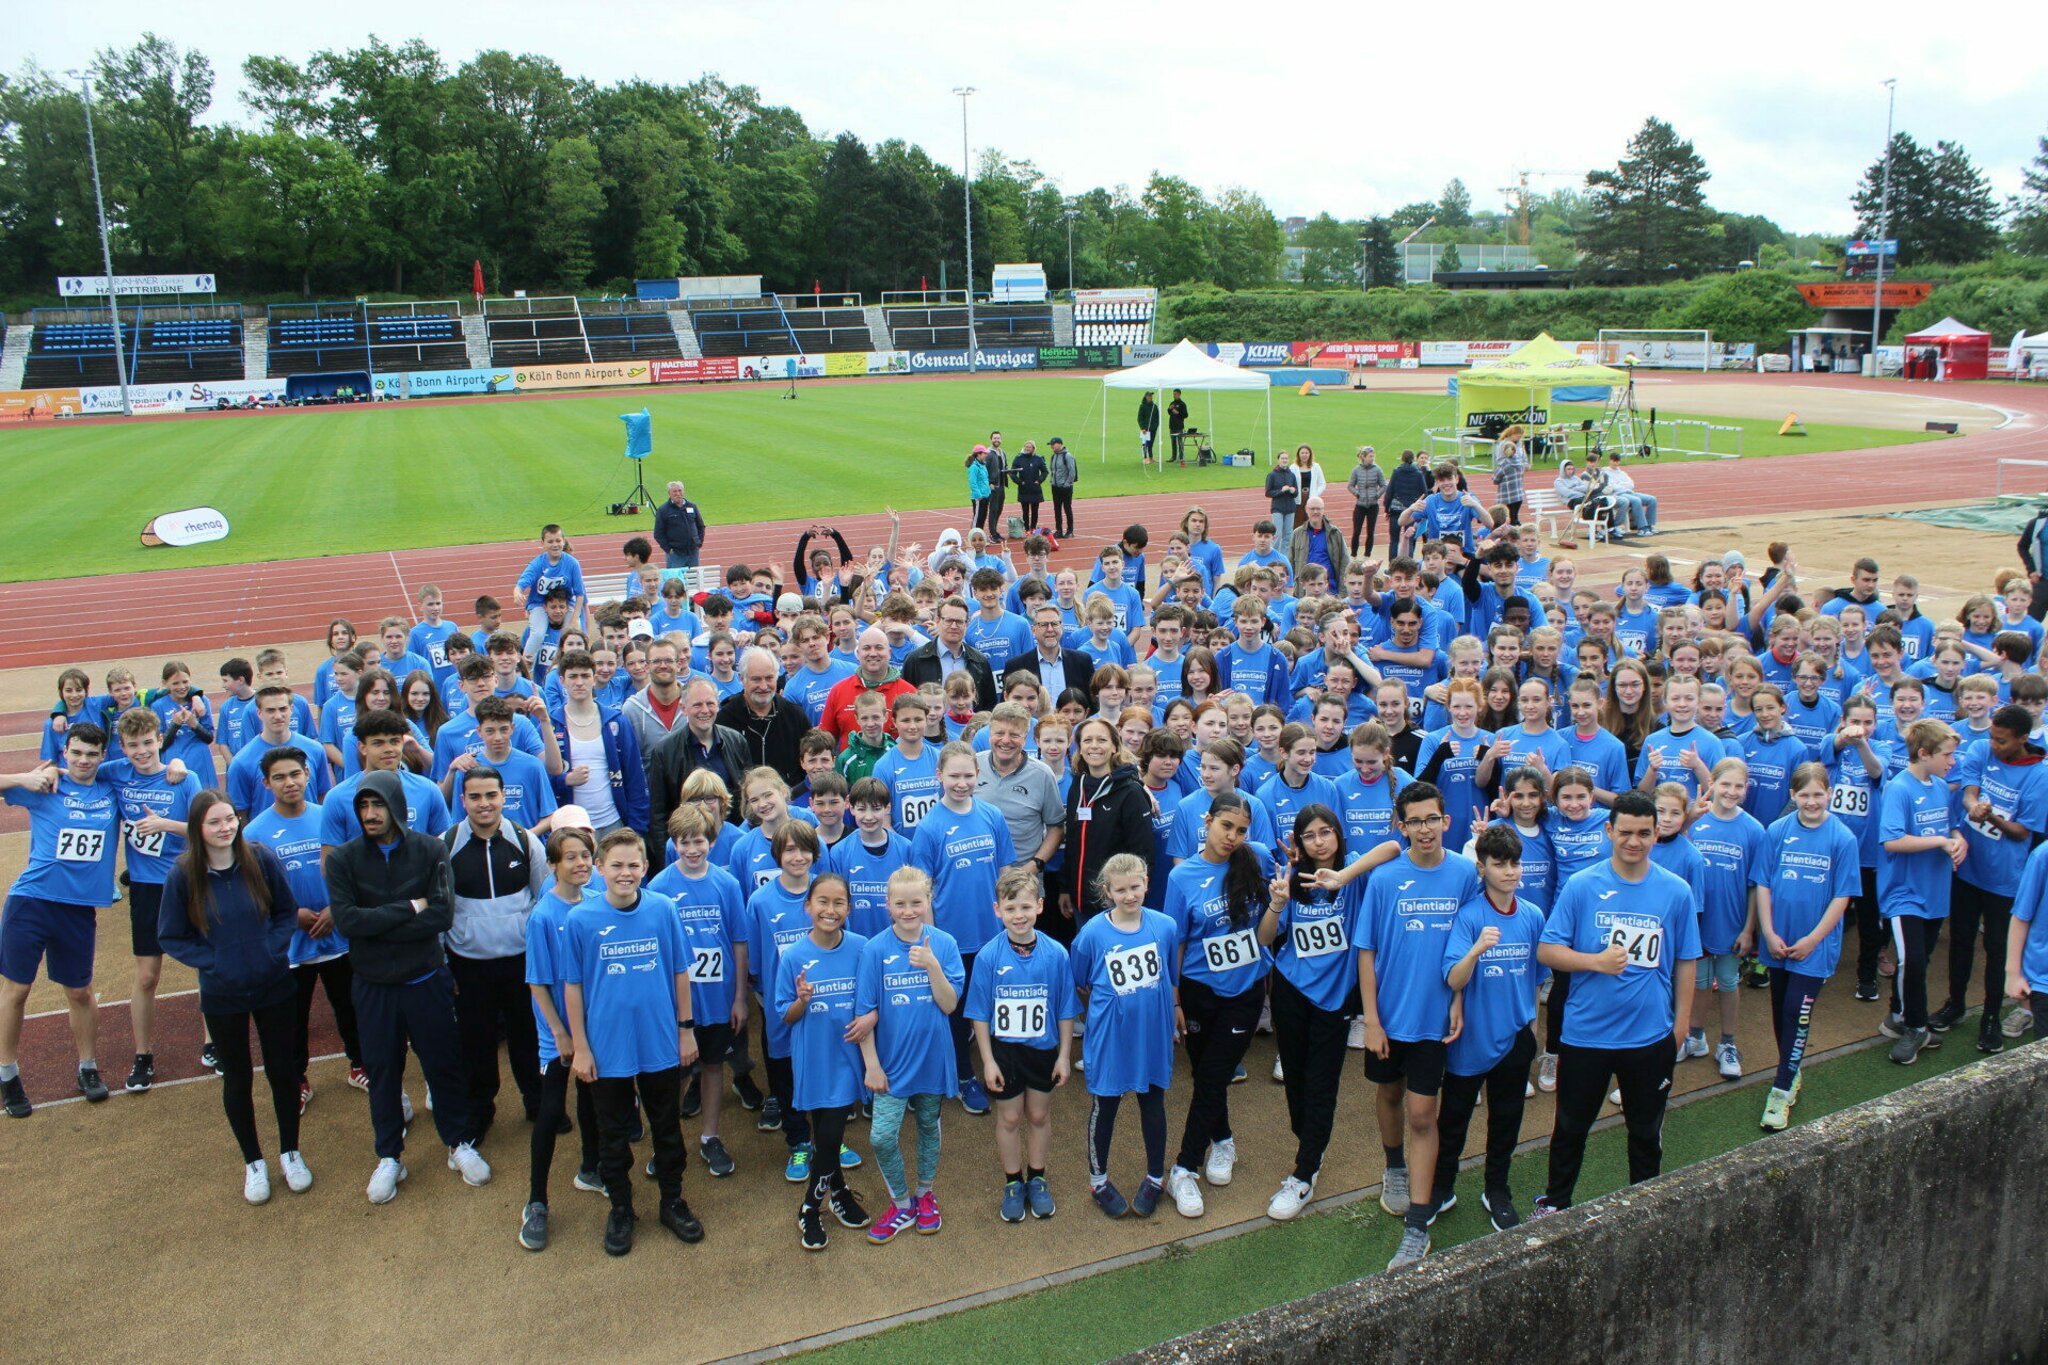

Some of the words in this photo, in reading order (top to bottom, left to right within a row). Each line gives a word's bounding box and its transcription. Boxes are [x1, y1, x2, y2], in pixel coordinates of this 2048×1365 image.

[911, 351, 969, 368] General
[974, 349, 1035, 368] Anzeiger
[388, 378, 412, 389] Kön
[416, 376, 442, 387] Bonn
[446, 374, 486, 387] Airport
[529, 371, 552, 381] Köln
[556, 369, 581, 380] Bonn
[585, 367, 623, 381] Airport
[185, 519, 223, 533] rhenag
[1386, 667, 1423, 676] Talentiade
[124, 788, 172, 801] Talentiade
[1833, 788, 1868, 812] 839
[1347, 810, 1391, 820] Talentiade
[60, 831, 103, 857] 767
[949, 838, 993, 854] Talentiade
[1781, 854, 1829, 868] Talentiade
[1400, 900, 1456, 912] Talentiade
[1294, 921, 1343, 952] 099
[602, 941, 658, 956] Talentiade
[1207, 933, 1256, 967] 661
[1612, 929, 1660, 962] 640
[1109, 949, 1158, 987] 838
[999, 985, 1048, 998] Talentiade
[996, 1004, 1045, 1033] 816
